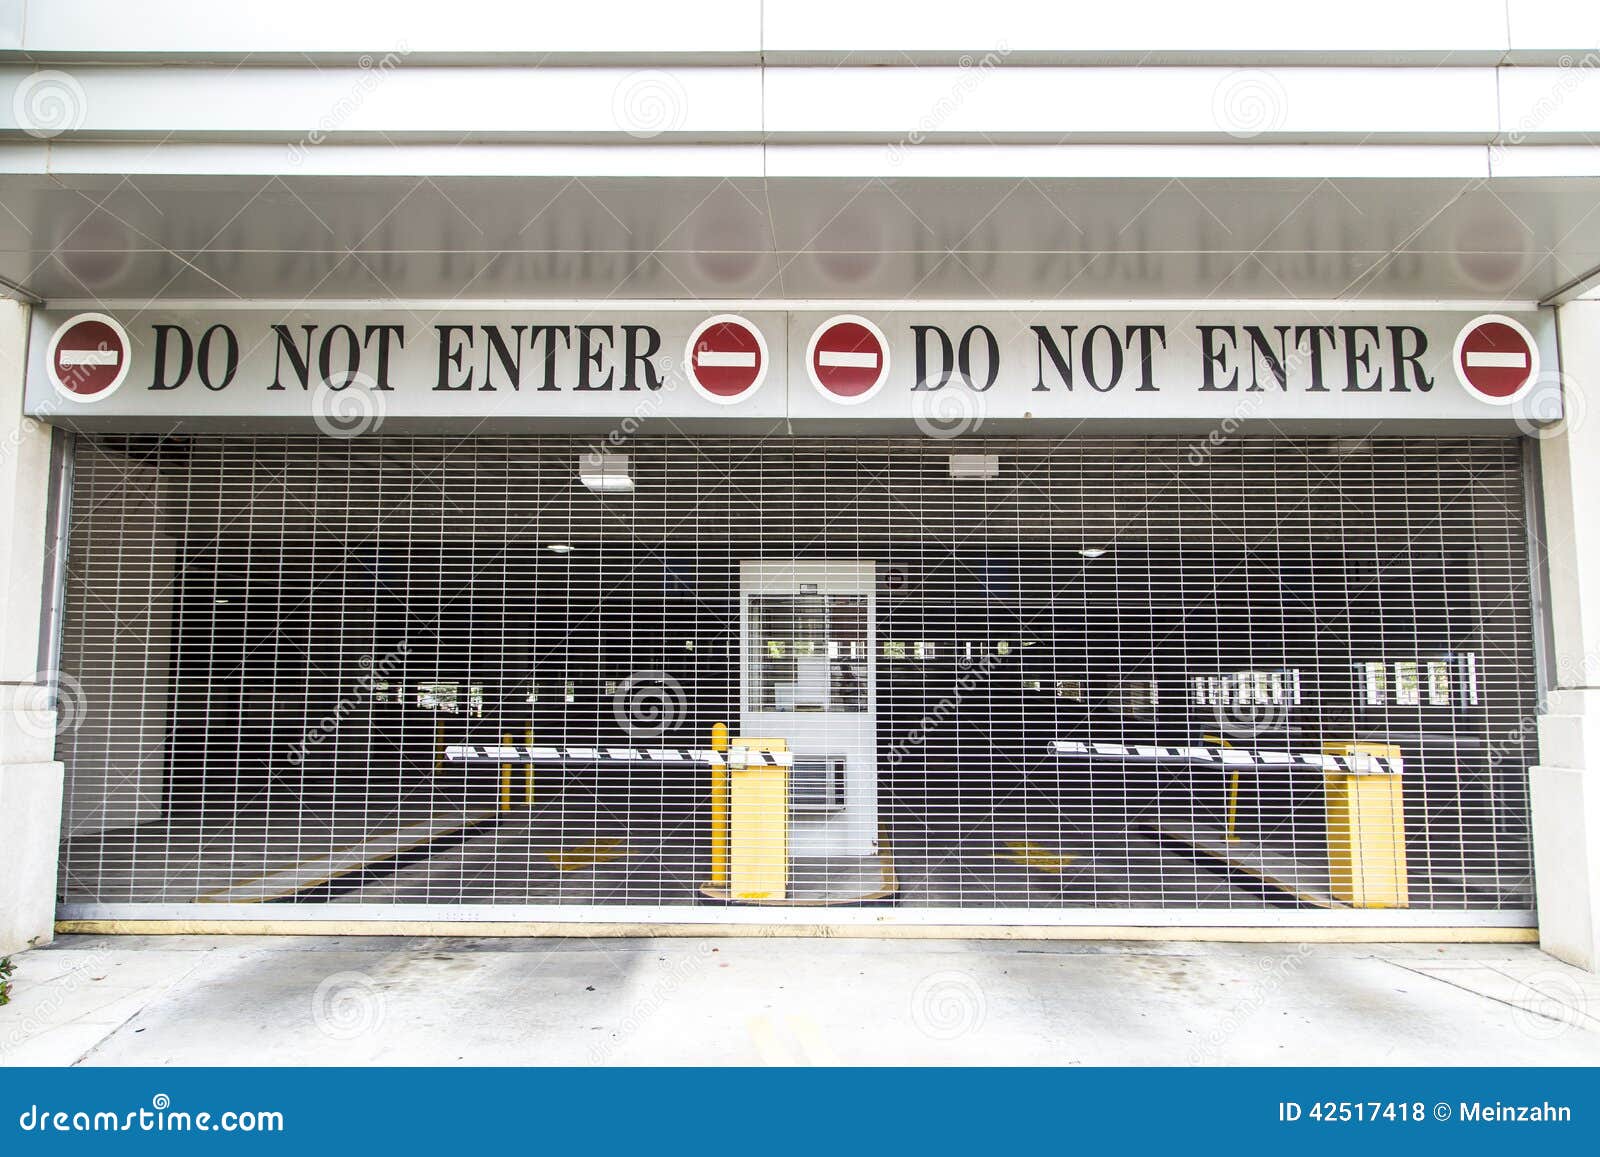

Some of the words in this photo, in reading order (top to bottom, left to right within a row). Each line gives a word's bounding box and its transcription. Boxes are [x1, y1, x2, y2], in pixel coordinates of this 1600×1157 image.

[148, 323, 239, 392] DO
[266, 324, 405, 392] NOT
[432, 324, 665, 392] ENTER
[910, 324, 1000, 392] DO
[1031, 324, 1167, 393] NOT
[1195, 325, 1435, 393] ENTER
